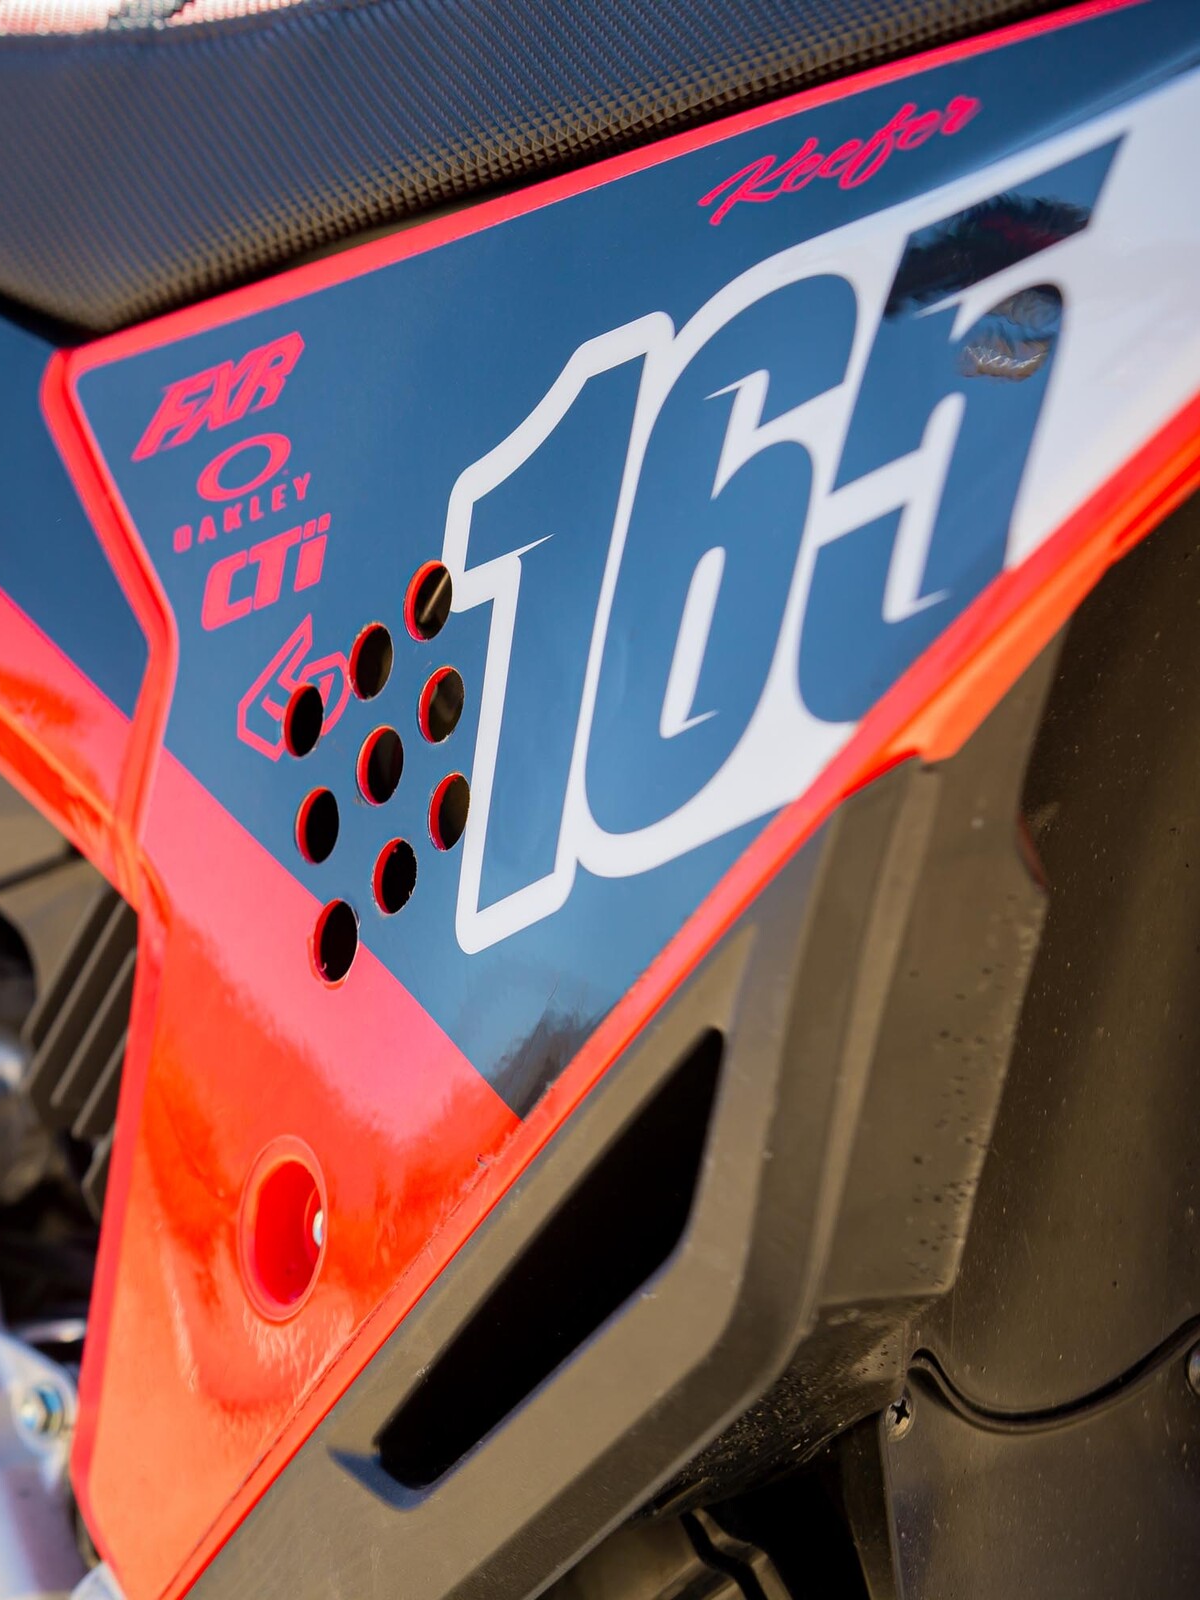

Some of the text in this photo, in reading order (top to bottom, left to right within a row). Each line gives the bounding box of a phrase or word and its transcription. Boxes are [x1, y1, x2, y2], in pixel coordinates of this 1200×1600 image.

[697, 95, 982, 226] Keefer
[131, 331, 305, 462] FXR
[173, 473, 312, 554] OAKLEY
[442, 128, 1132, 952] 165
